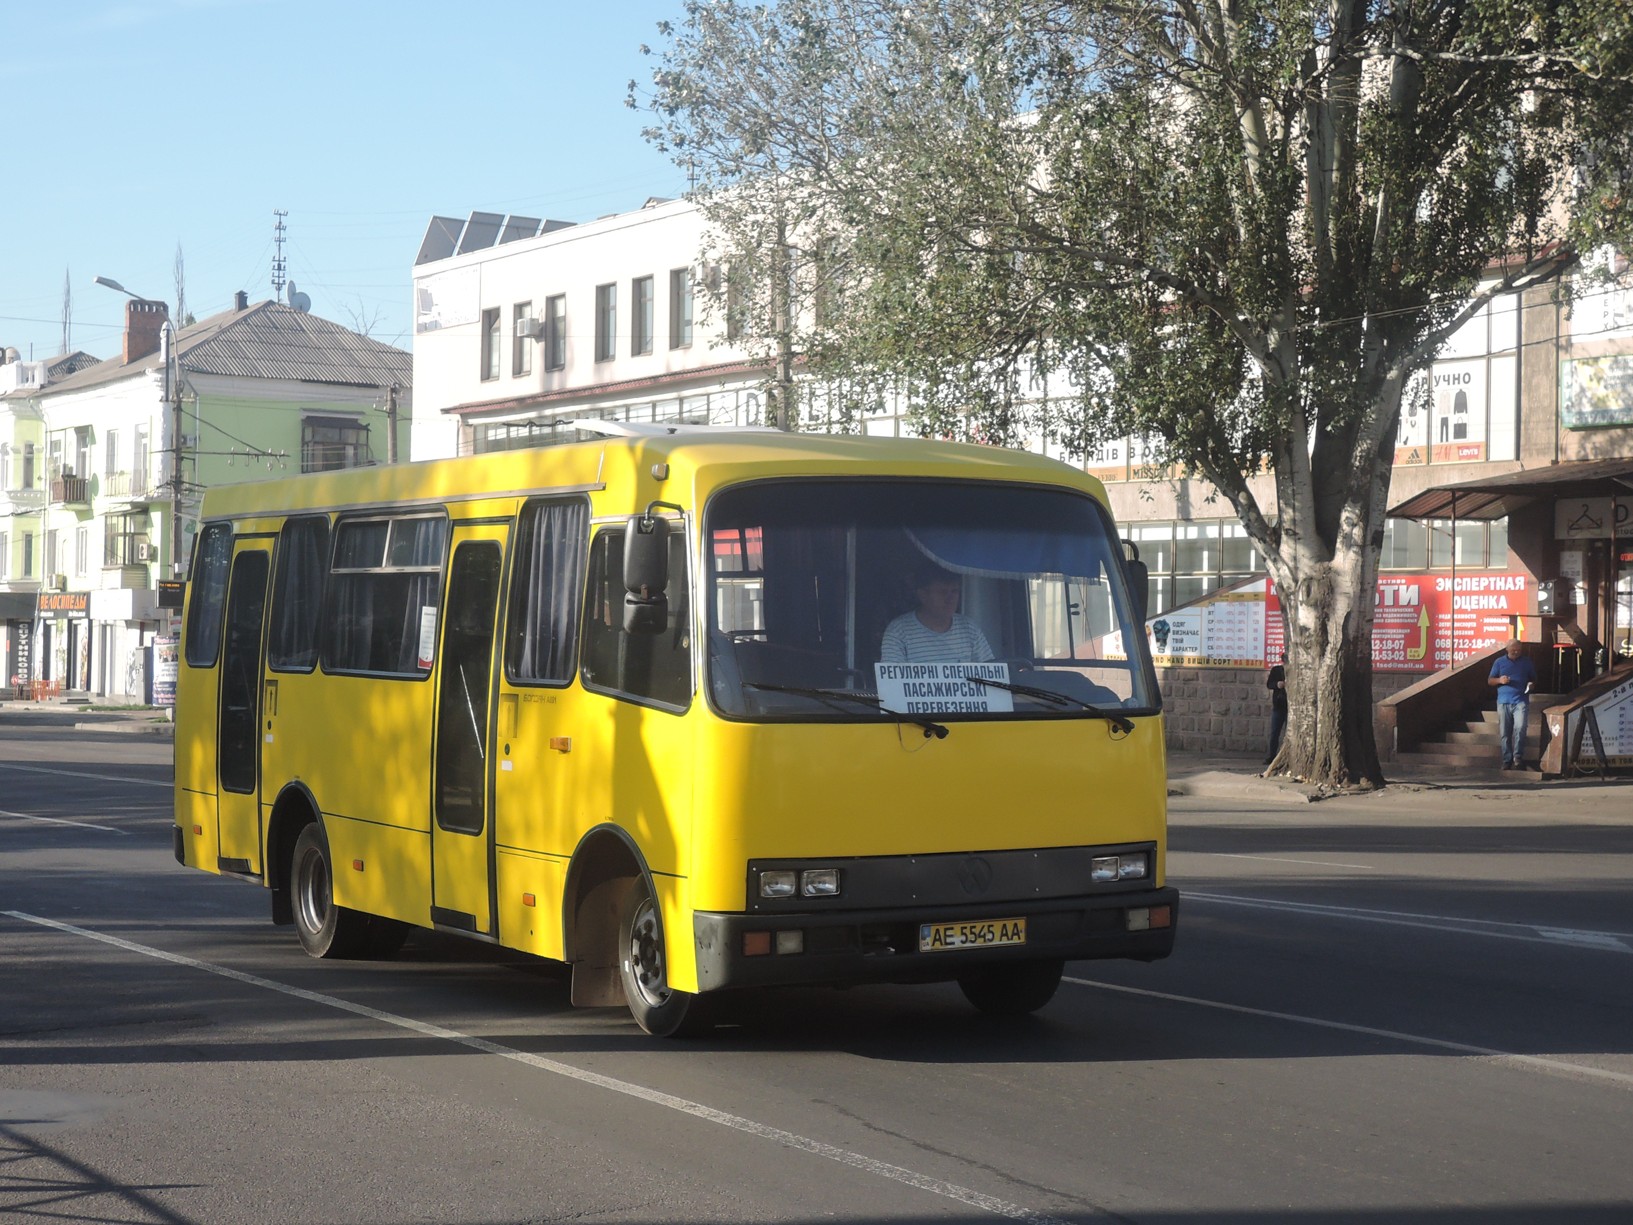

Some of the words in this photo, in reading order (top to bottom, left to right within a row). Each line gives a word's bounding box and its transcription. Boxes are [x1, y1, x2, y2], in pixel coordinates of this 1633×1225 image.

[1436, 576, 1524, 592] ЭКСПЕРТНАЯ
[40, 595, 87, 609] ВЕЛОСИПЕДЫ
[1454, 595, 1508, 611] ОЦЕНКА
[880, 665, 939, 680] РЕГУЛЯРНІ
[943, 665, 1005, 680] СПЕЦІАЛЬНІ
[903, 682, 987, 698] ПАСАЖИРСЬКІ
[907, 701, 988, 713] ПЕРЕВЕЗЕННЯ
[932, 927, 956, 947] AE
[960, 924, 995, 944] 5545
[1000, 922, 1021, 942] AA
